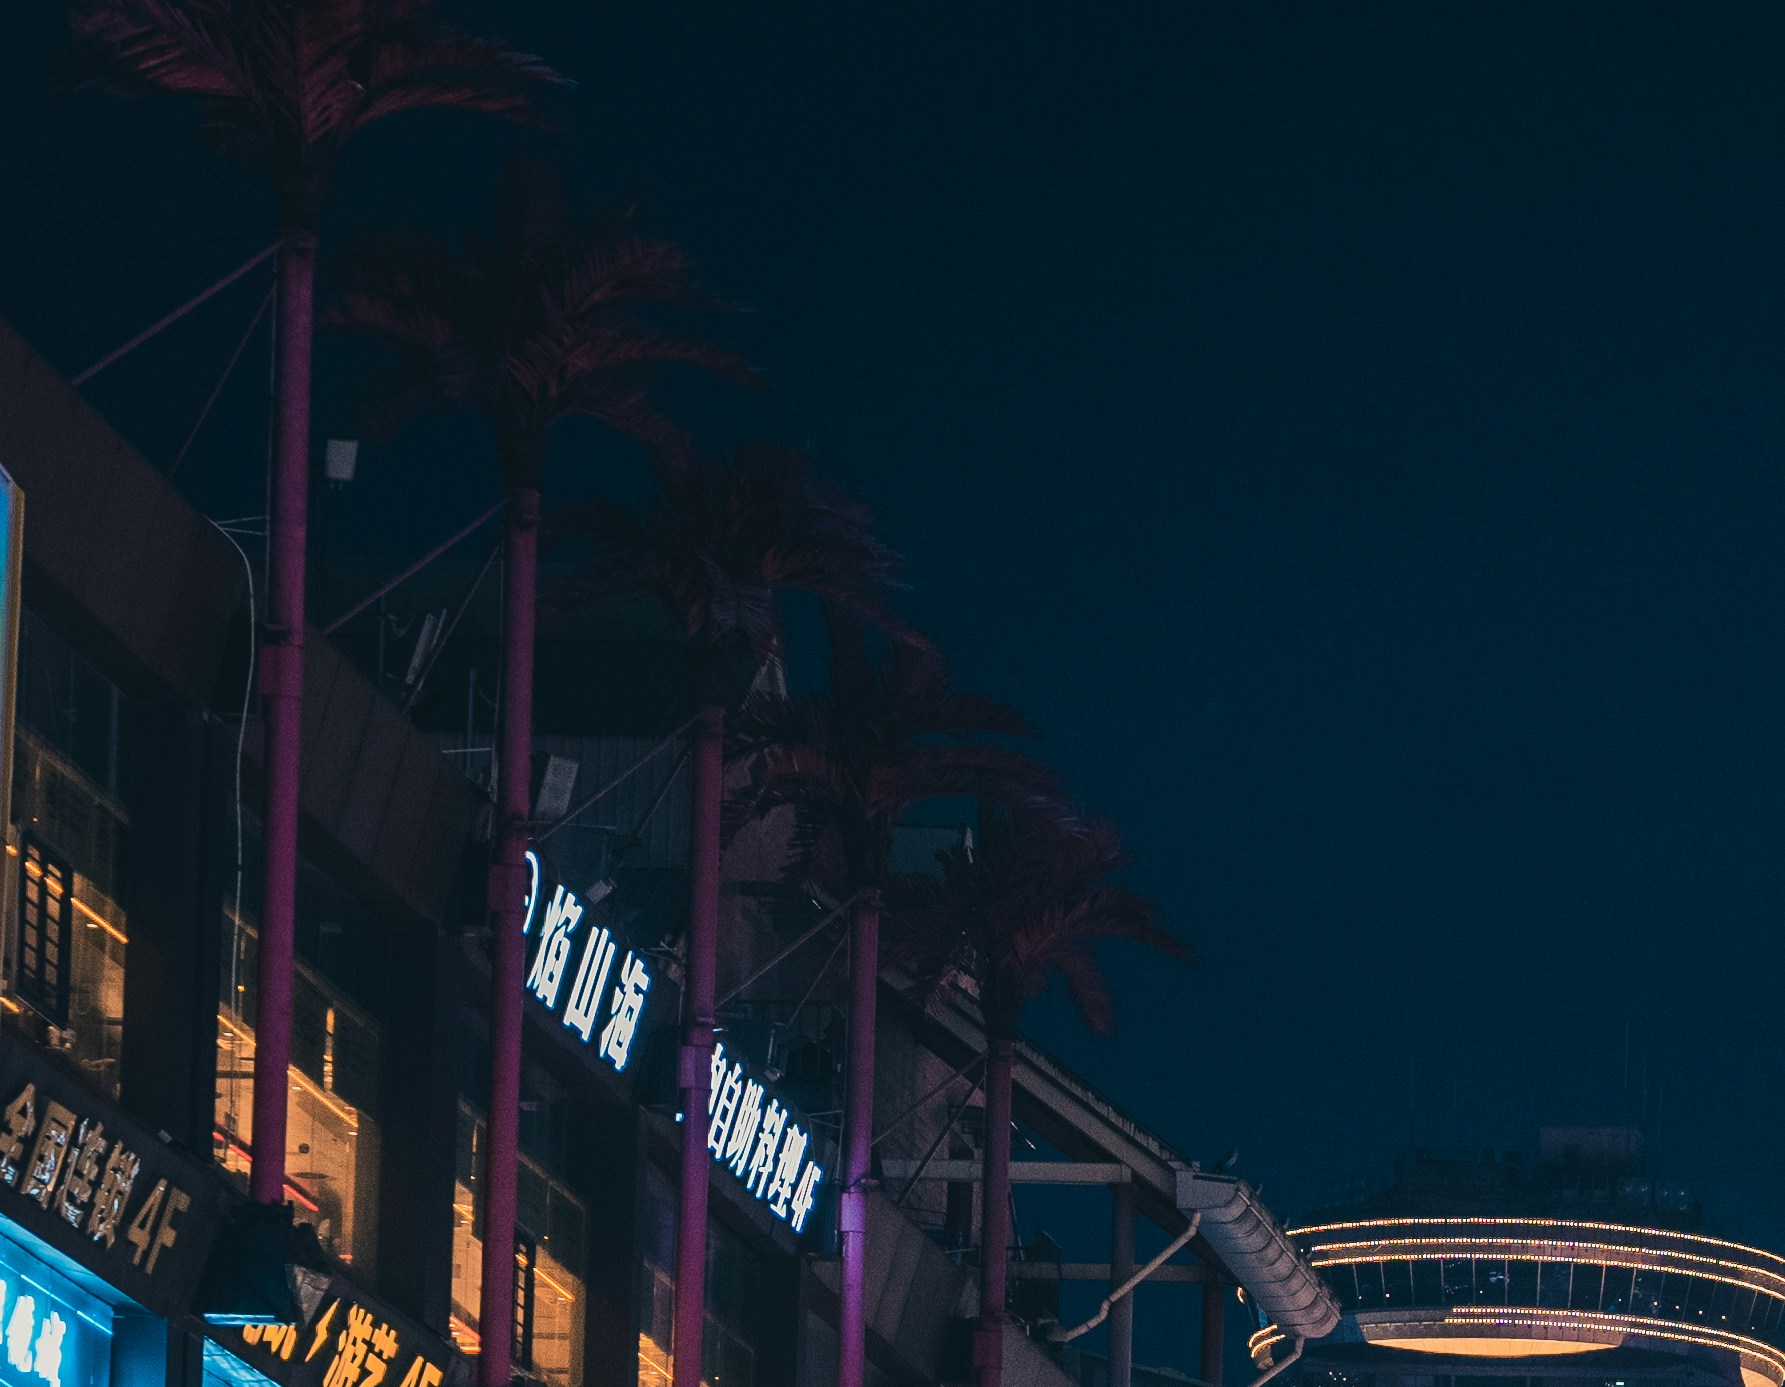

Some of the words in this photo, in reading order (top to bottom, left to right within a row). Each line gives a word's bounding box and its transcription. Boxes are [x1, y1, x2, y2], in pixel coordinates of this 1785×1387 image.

[526, 884, 651, 1071] 焰山海
[128, 1178, 191, 1274] 4F
